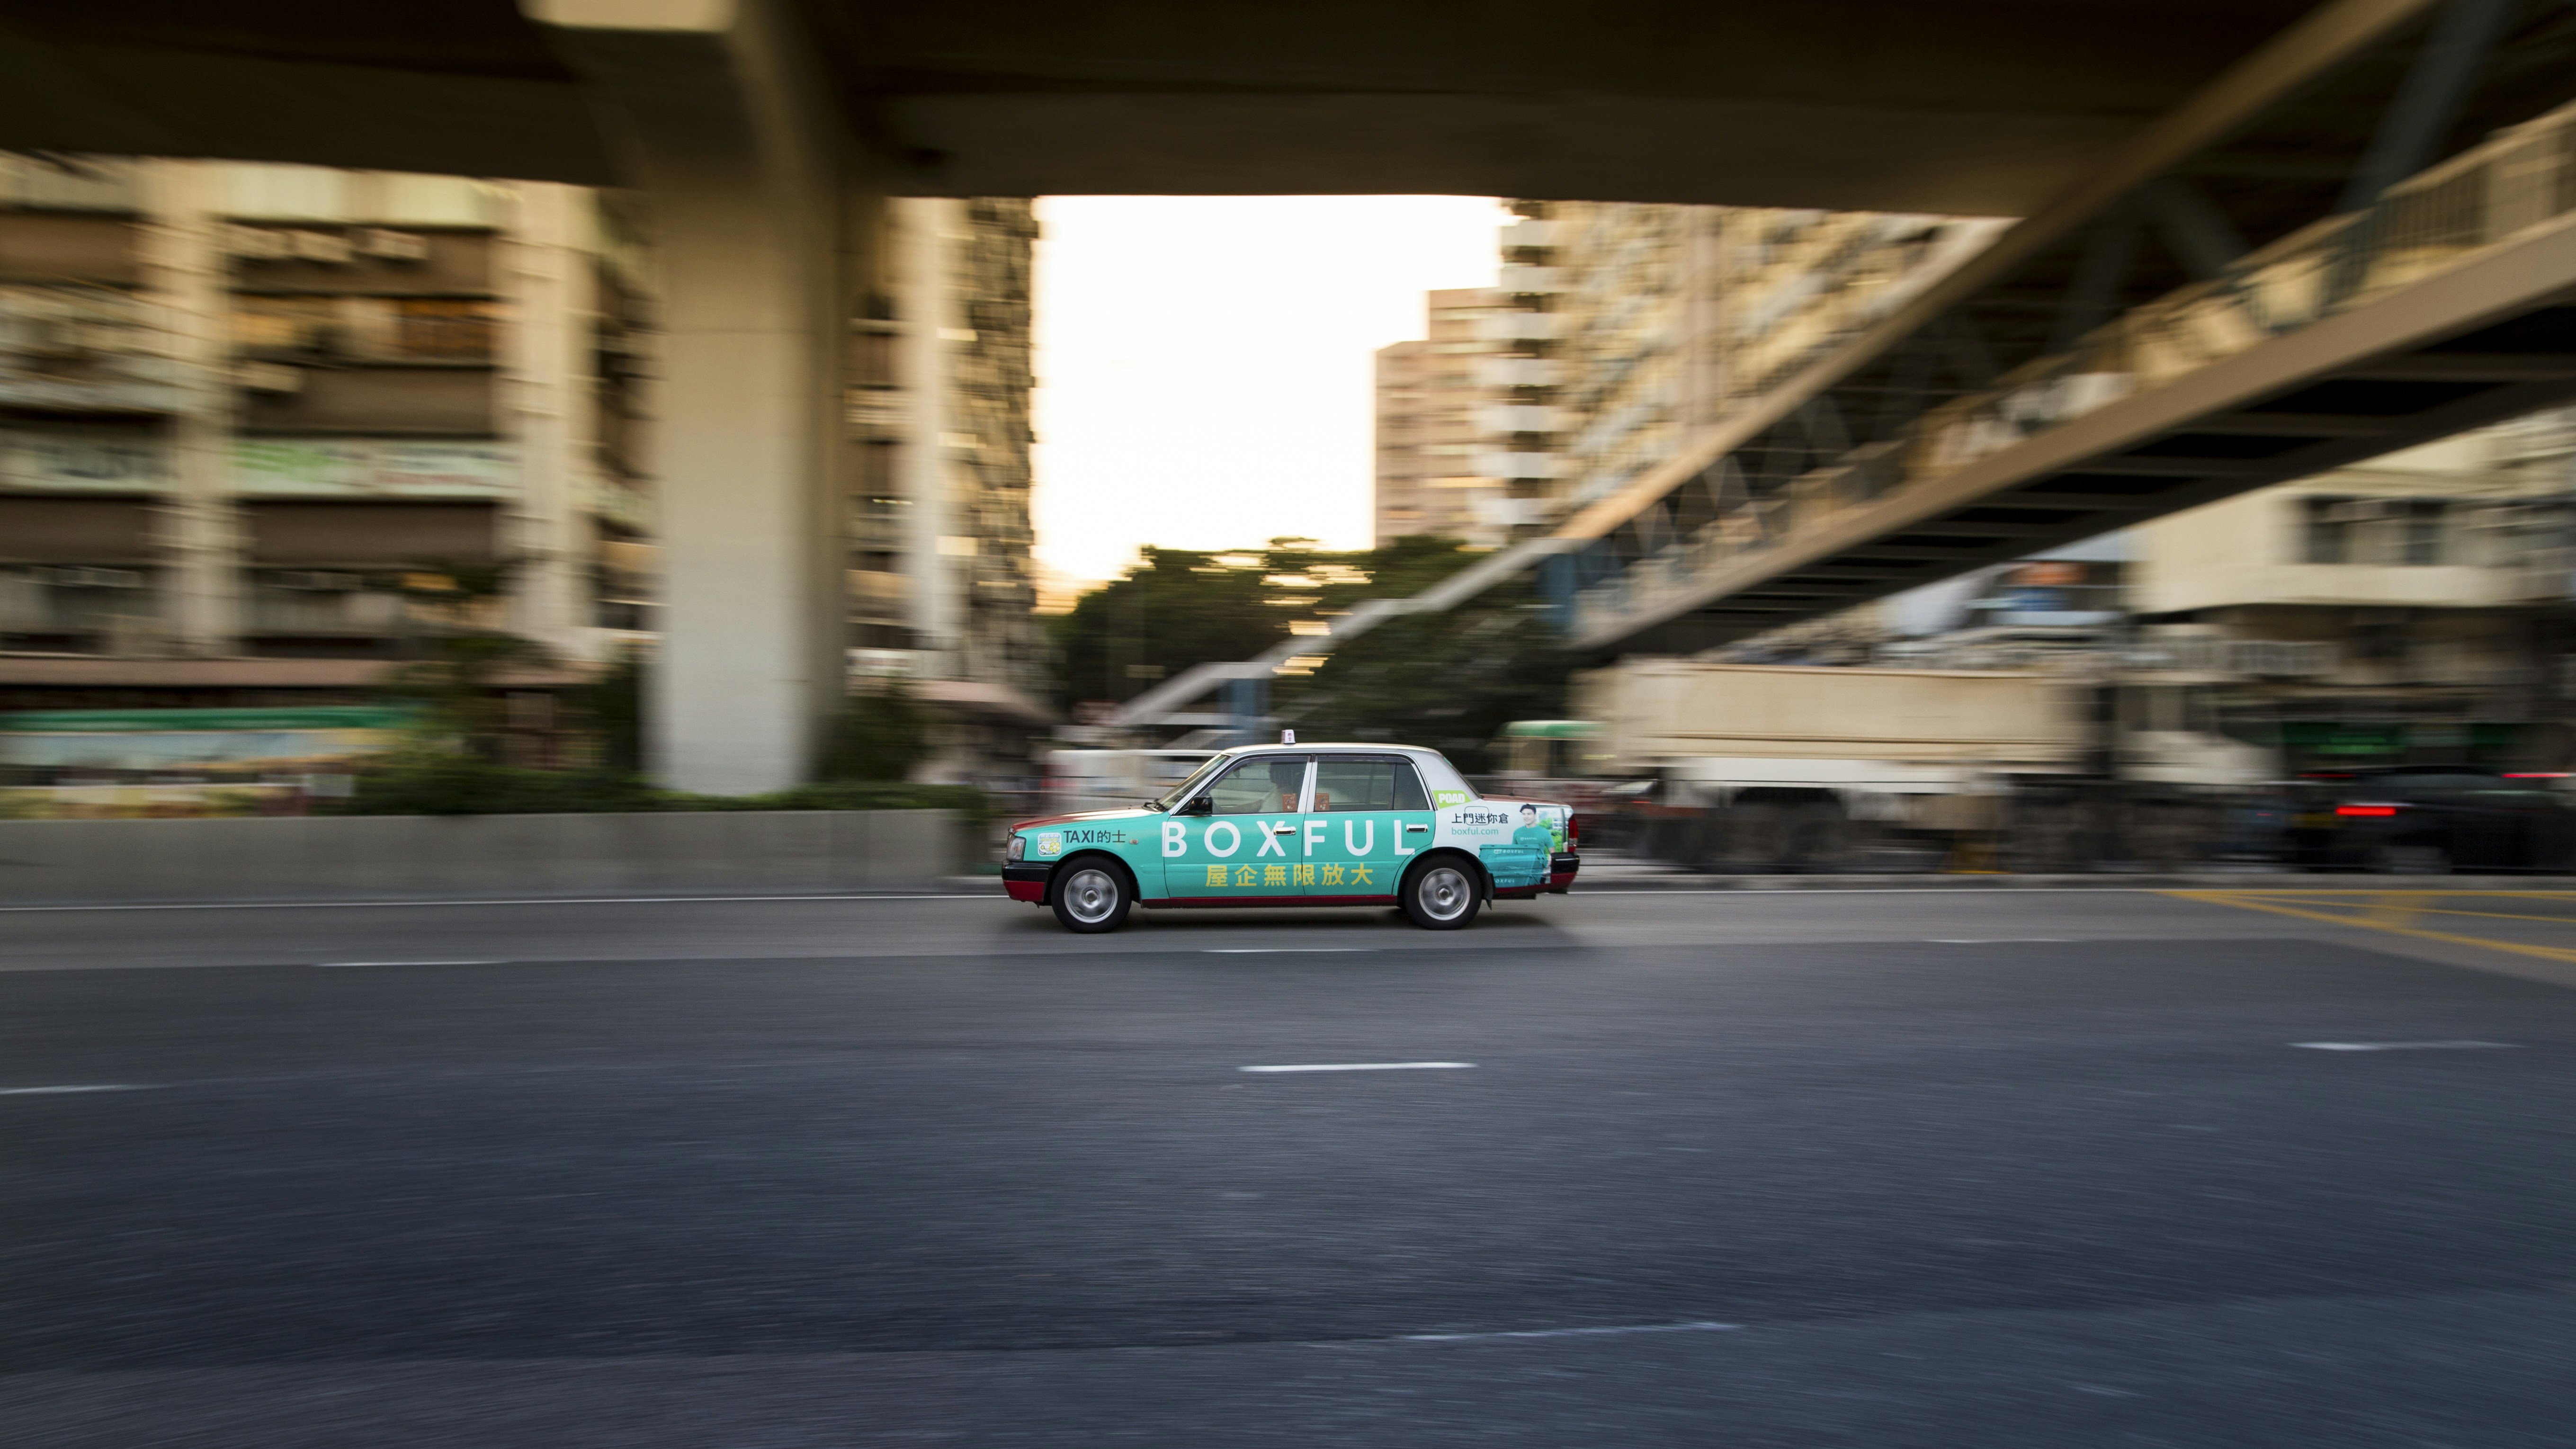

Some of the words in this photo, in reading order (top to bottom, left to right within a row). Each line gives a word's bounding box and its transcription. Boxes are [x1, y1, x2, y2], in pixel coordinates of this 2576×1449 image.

[1438, 793, 1465, 804] POAD
[1451, 813, 1509, 824] 上門迷你倉
[1064, 830, 1094, 843] TAXI
[1097, 830, 1126, 843] 的士
[1451, 827, 1499, 835] boxful.com
[1162, 820, 1415, 858] BOXFUL
[1206, 863, 1373, 887] 屋企無限放大
